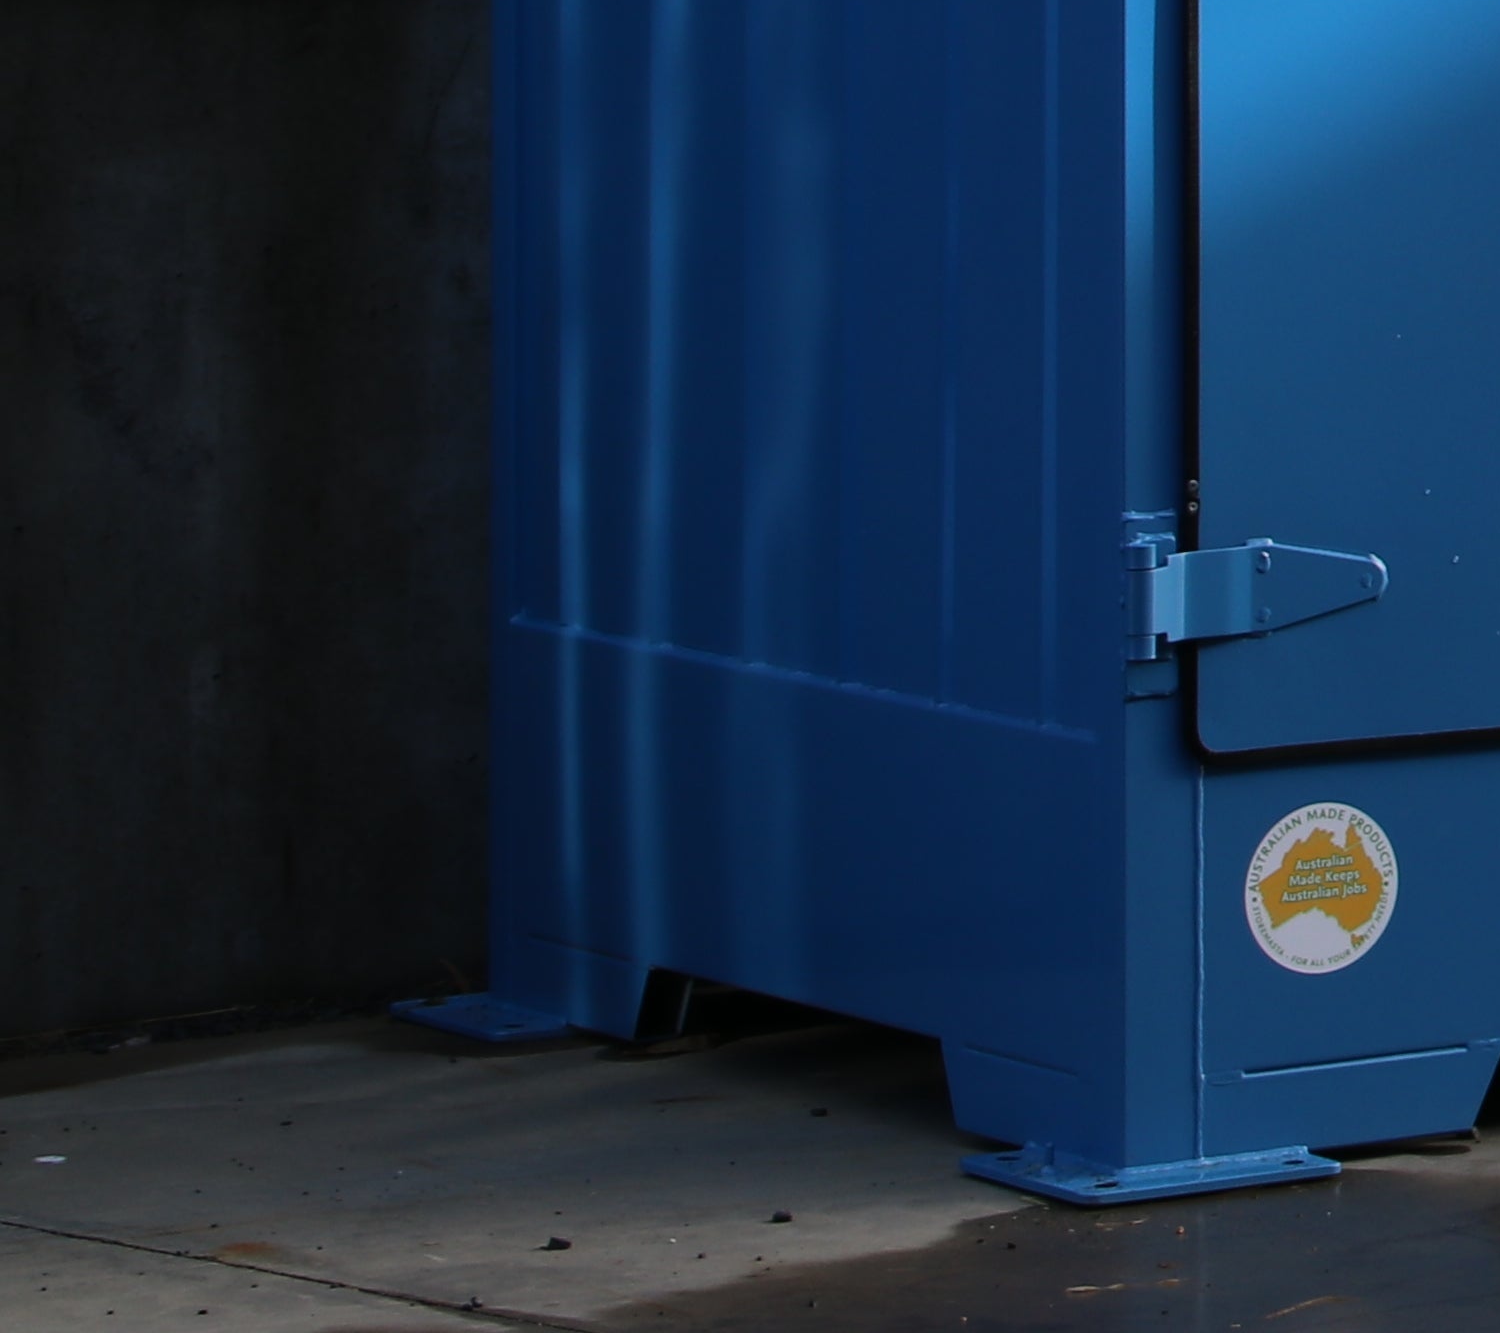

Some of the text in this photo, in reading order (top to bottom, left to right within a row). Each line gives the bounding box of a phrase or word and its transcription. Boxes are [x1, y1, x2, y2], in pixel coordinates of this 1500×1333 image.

[1248, 807, 1394, 893] AUSTRALIAN MADE PRODUCTS
[1295, 854, 1354, 871] Australian
[1288, 869, 1360, 887] Made Keeps
[1281, 882, 1368, 903] Australian Jobs
[1291, 954, 1308, 966] FOR
[1310, 958, 1324, 967] ALL
[1327, 948, 1351, 964] YOUR
